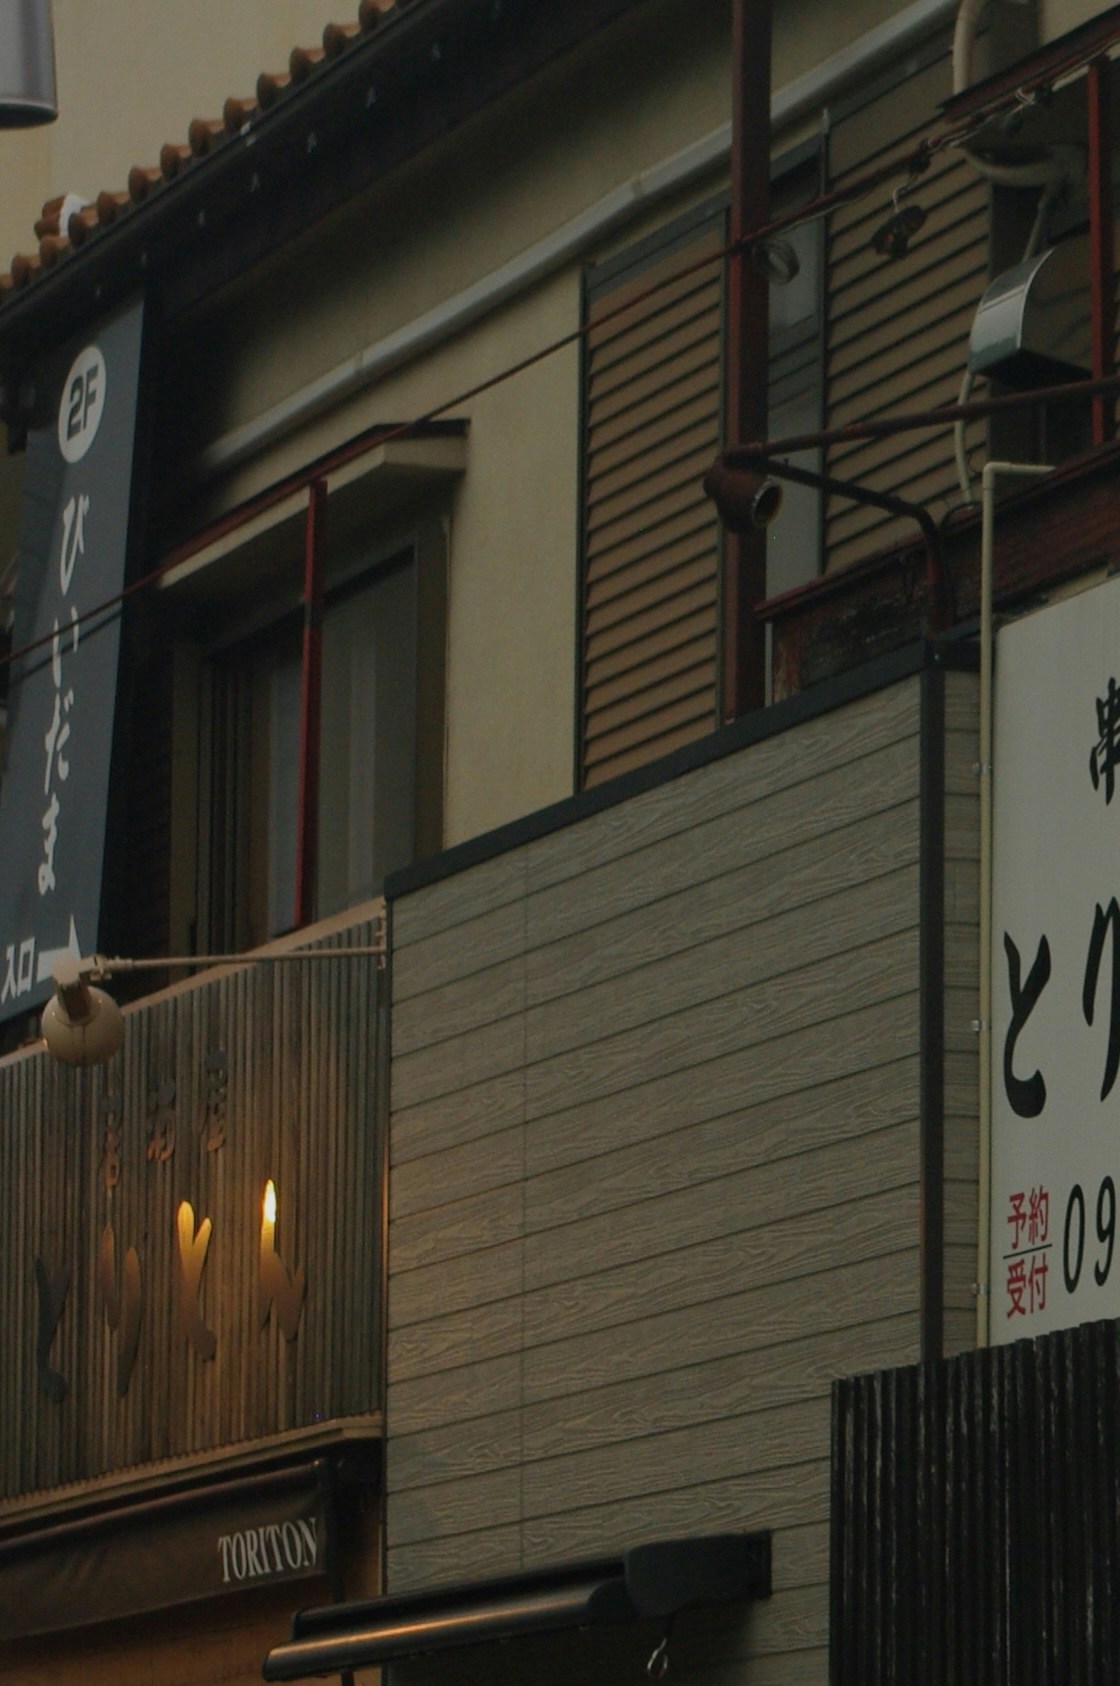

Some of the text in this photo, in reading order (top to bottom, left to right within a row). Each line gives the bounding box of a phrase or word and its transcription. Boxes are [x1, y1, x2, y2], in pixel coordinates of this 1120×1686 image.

[67, 363, 100, 441] 2F
[0, 935, 36, 1004] 入口
[1007, 1184, 1049, 1250] 予約
[35, 1177, 307, 1403] とりとん
[1006, 1252, 1049, 1319] 受付
[217, 1517, 317, 1583] TORITON
